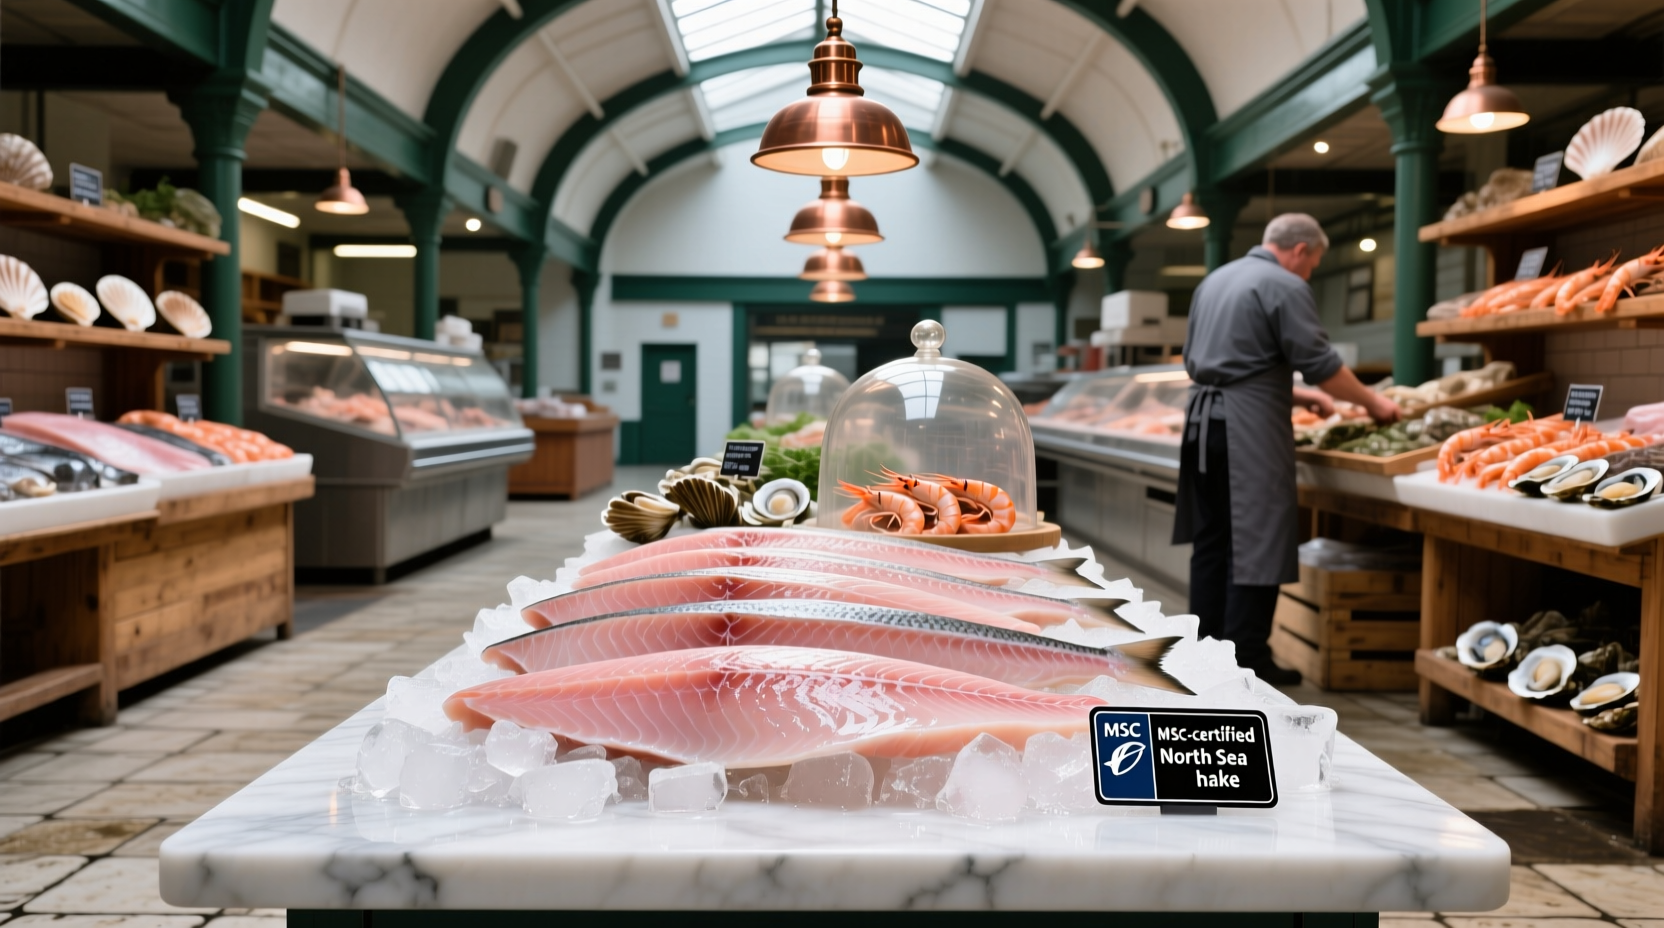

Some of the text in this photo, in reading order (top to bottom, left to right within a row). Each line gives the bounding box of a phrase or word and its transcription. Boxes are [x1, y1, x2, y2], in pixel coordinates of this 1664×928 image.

[1104, 722, 1141, 738] MSC
[1157, 726, 1256, 743] MSC-certified
[1160, 747, 1248, 766] North Sea
[1196, 769, 1240, 788] hake
